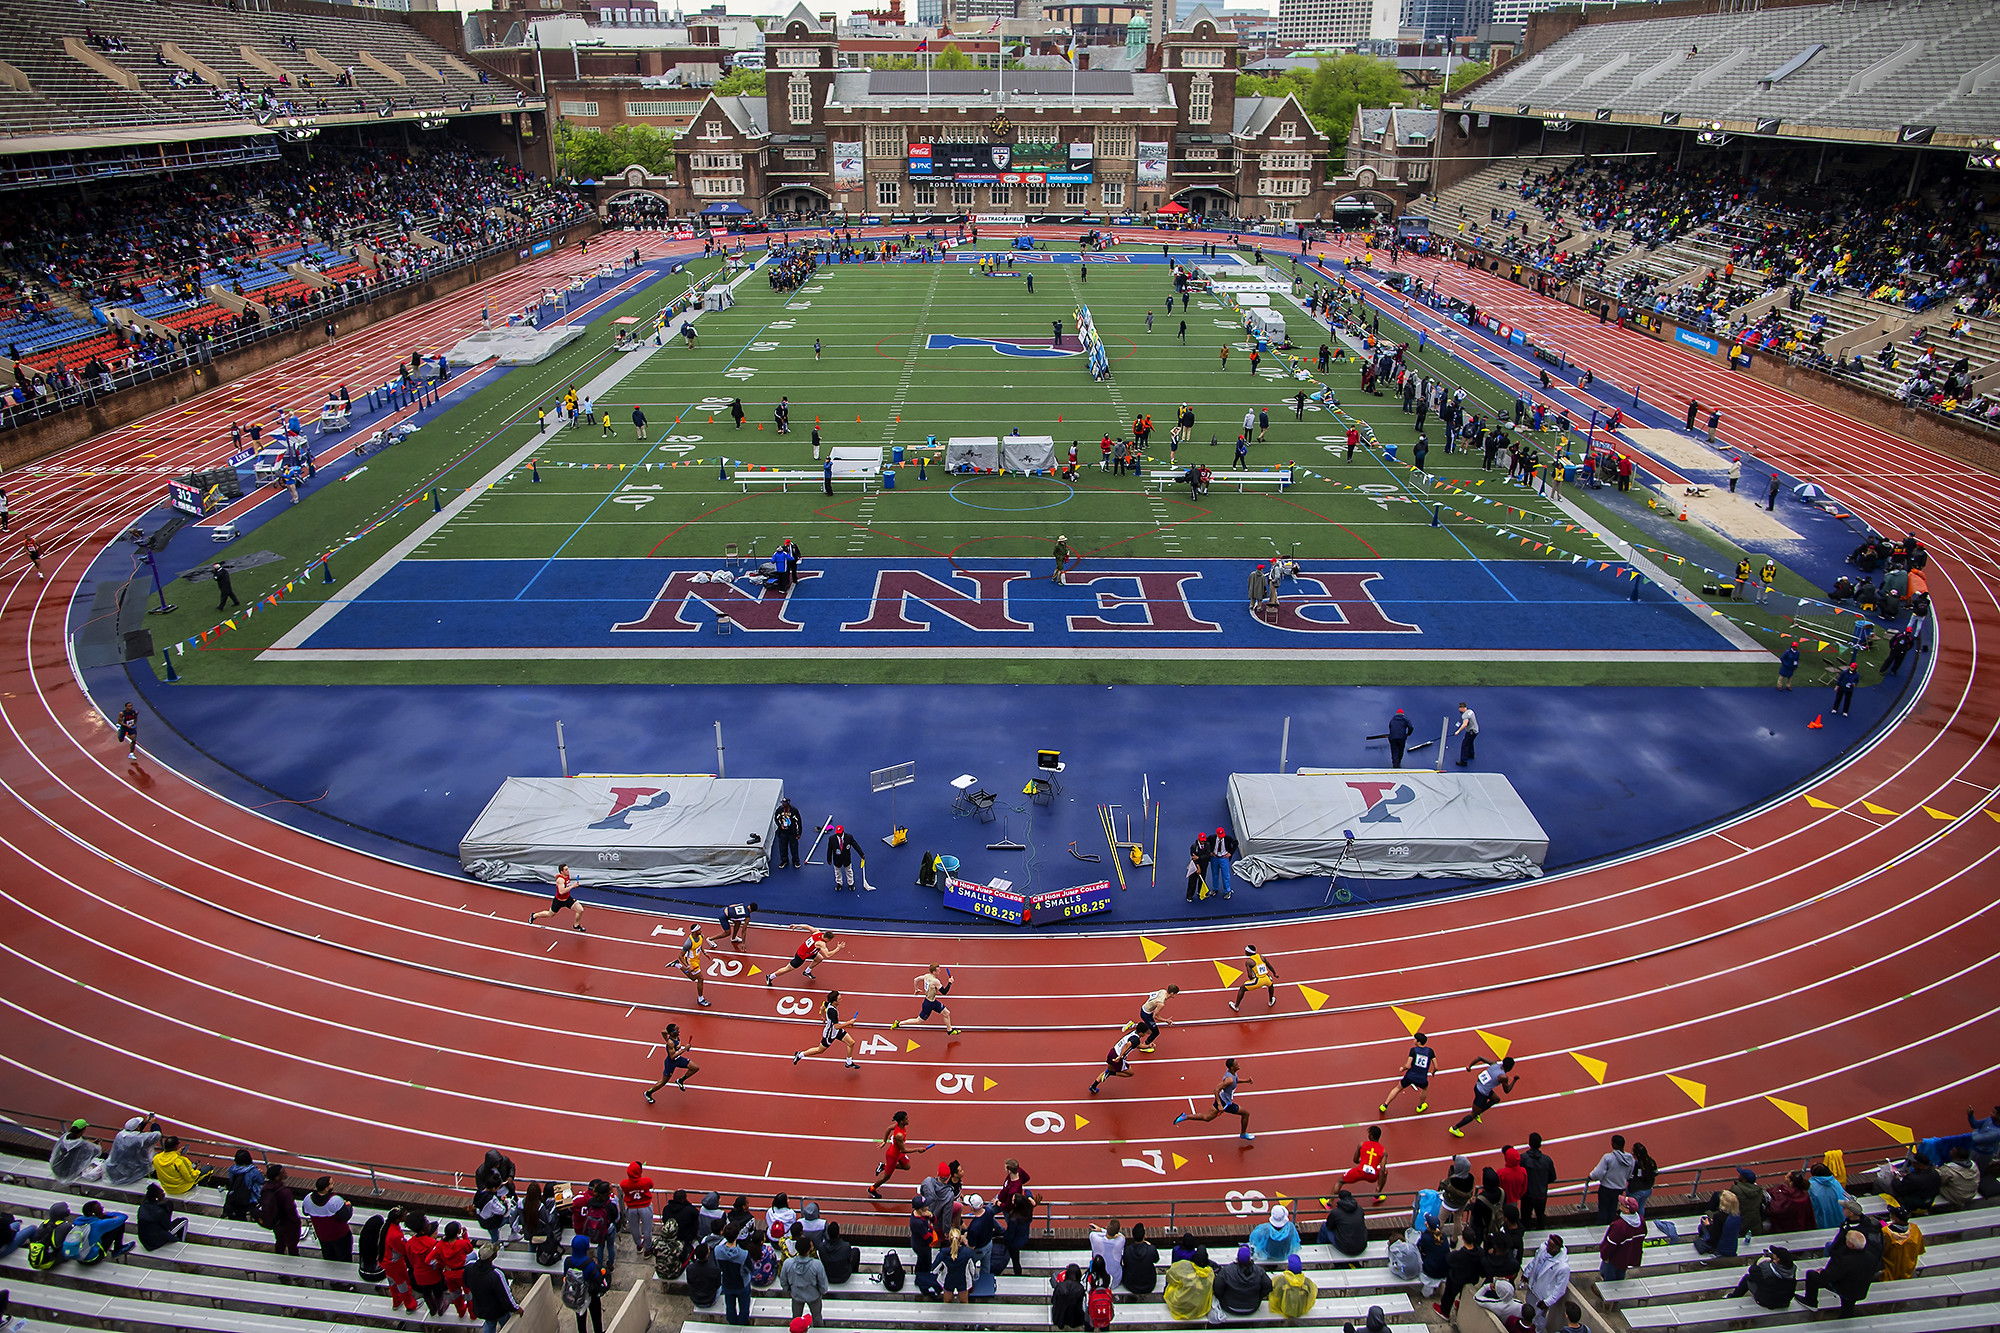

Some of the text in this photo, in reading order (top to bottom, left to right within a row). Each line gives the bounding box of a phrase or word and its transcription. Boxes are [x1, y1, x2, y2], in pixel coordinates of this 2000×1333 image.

[920, 135, 1058, 144] FRANKLIN FIELD
[659, 435, 704, 452] 20
[176, 488, 192, 503] 312
[613, 484, 664, 504] 10
[948, 885, 994, 903] 4 SMALLS
[976, 885, 994, 895] JUMP
[994, 890, 1023, 903] COLLEGE
[1062, 889, 1079, 898] JUMP
[1080, 883, 1109, 894] COLLEGE
[1034, 894, 1082, 910] 4 SMALLS
[1063, 898, 1111, 917] 6'08.25"
[974, 902, 1022, 922] 6'08.25"
[650, 924, 686, 937] 1
[706, 958, 743, 977] 2
[776, 996, 814, 1016] 3
[859, 1034, 899, 1055] 4
[935, 1072, 975, 1095] 5
[1024, 1110, 1066, 1134] 6
[1121, 1149, 1167, 1175] 7
[1225, 1190, 1270, 1218] 8
